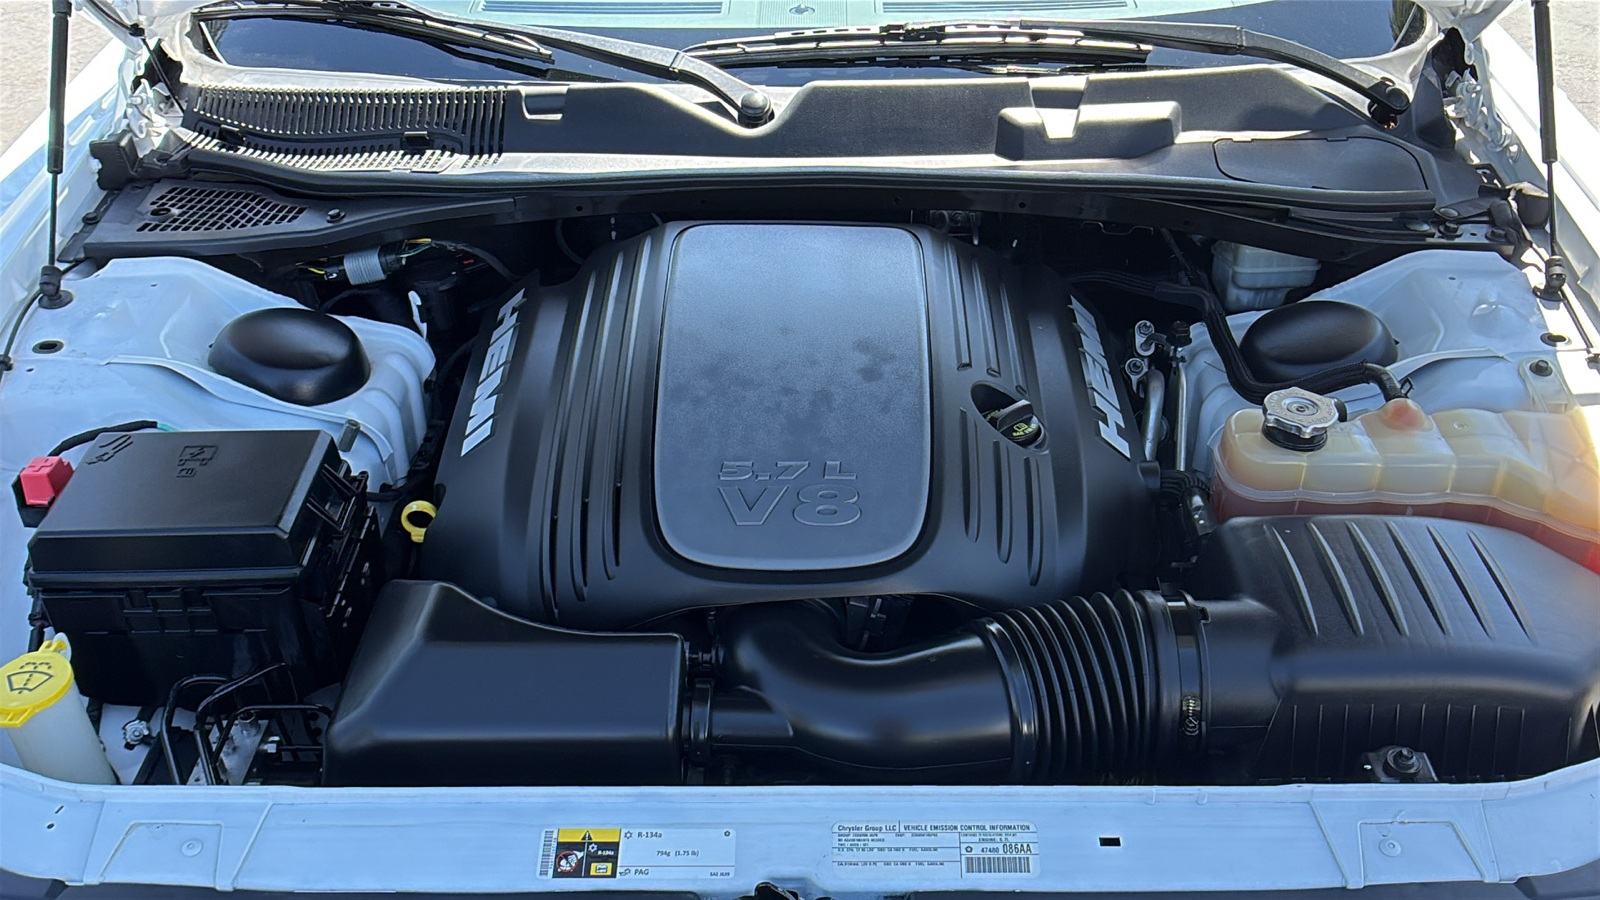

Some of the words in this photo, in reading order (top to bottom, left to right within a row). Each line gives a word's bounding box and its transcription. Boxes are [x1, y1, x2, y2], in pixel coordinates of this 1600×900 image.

[461, 288, 526, 457] HEMI
[1068, 294, 1131, 460] HEMI
[718, 461, 810, 481] 5.7
[823, 460, 857, 480] L
[718, 484, 862, 526] V8
[865, 825, 883, 833] Group
[1002, 843, 1032, 854] 086AA
